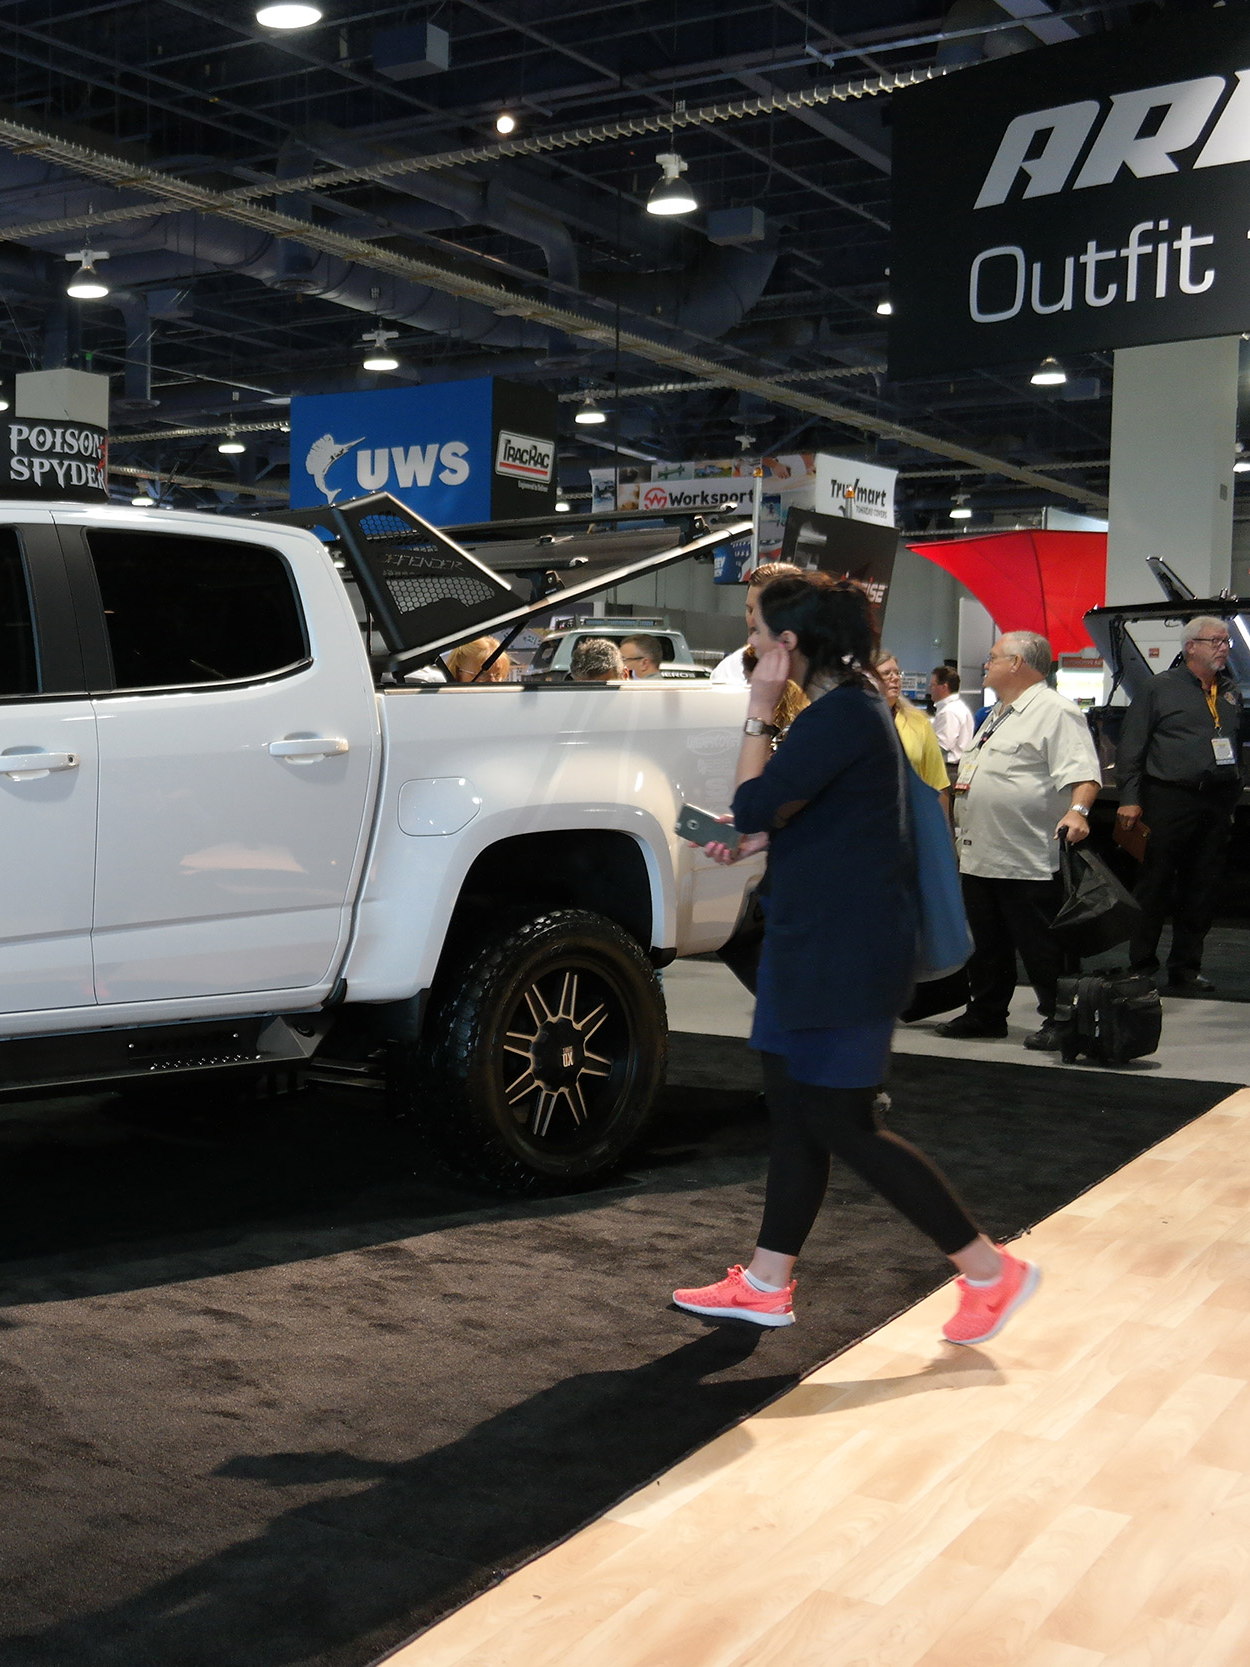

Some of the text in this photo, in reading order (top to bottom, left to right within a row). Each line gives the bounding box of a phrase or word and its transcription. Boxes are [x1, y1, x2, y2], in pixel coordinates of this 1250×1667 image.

[969, 219, 1215, 324] Outfit
[9, 424, 105, 460] POISON
[9, 456, 108, 493] SPYDER
[356, 441, 470, 491] UWS
[669, 488, 754, 504] Worksport
[382, 553, 466, 572] DEFENDER
